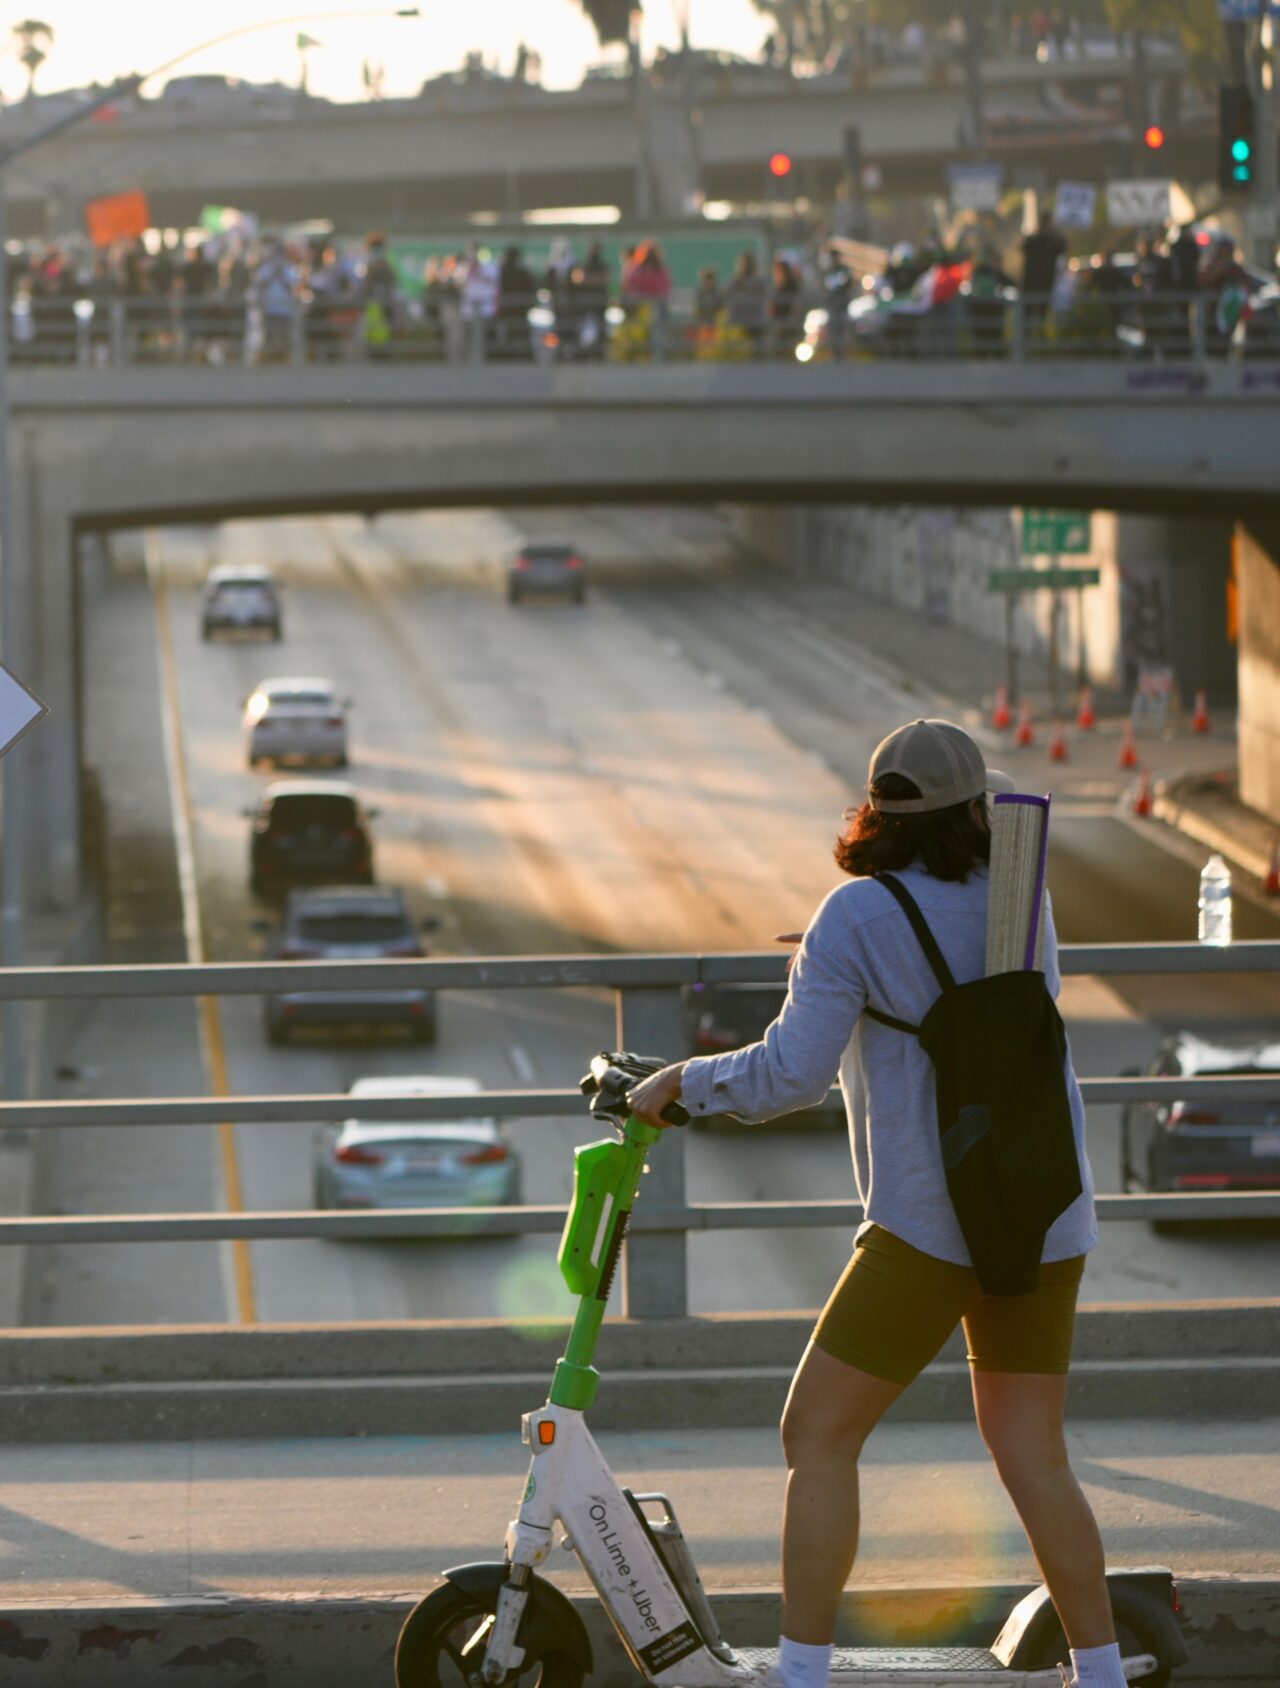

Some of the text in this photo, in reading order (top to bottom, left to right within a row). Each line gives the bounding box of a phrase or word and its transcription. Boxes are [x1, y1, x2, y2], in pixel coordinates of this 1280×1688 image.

[589, 1504, 609, 1533] On
[602, 1532, 631, 1577] Lime
[632, 1590, 662, 1633] Uber
